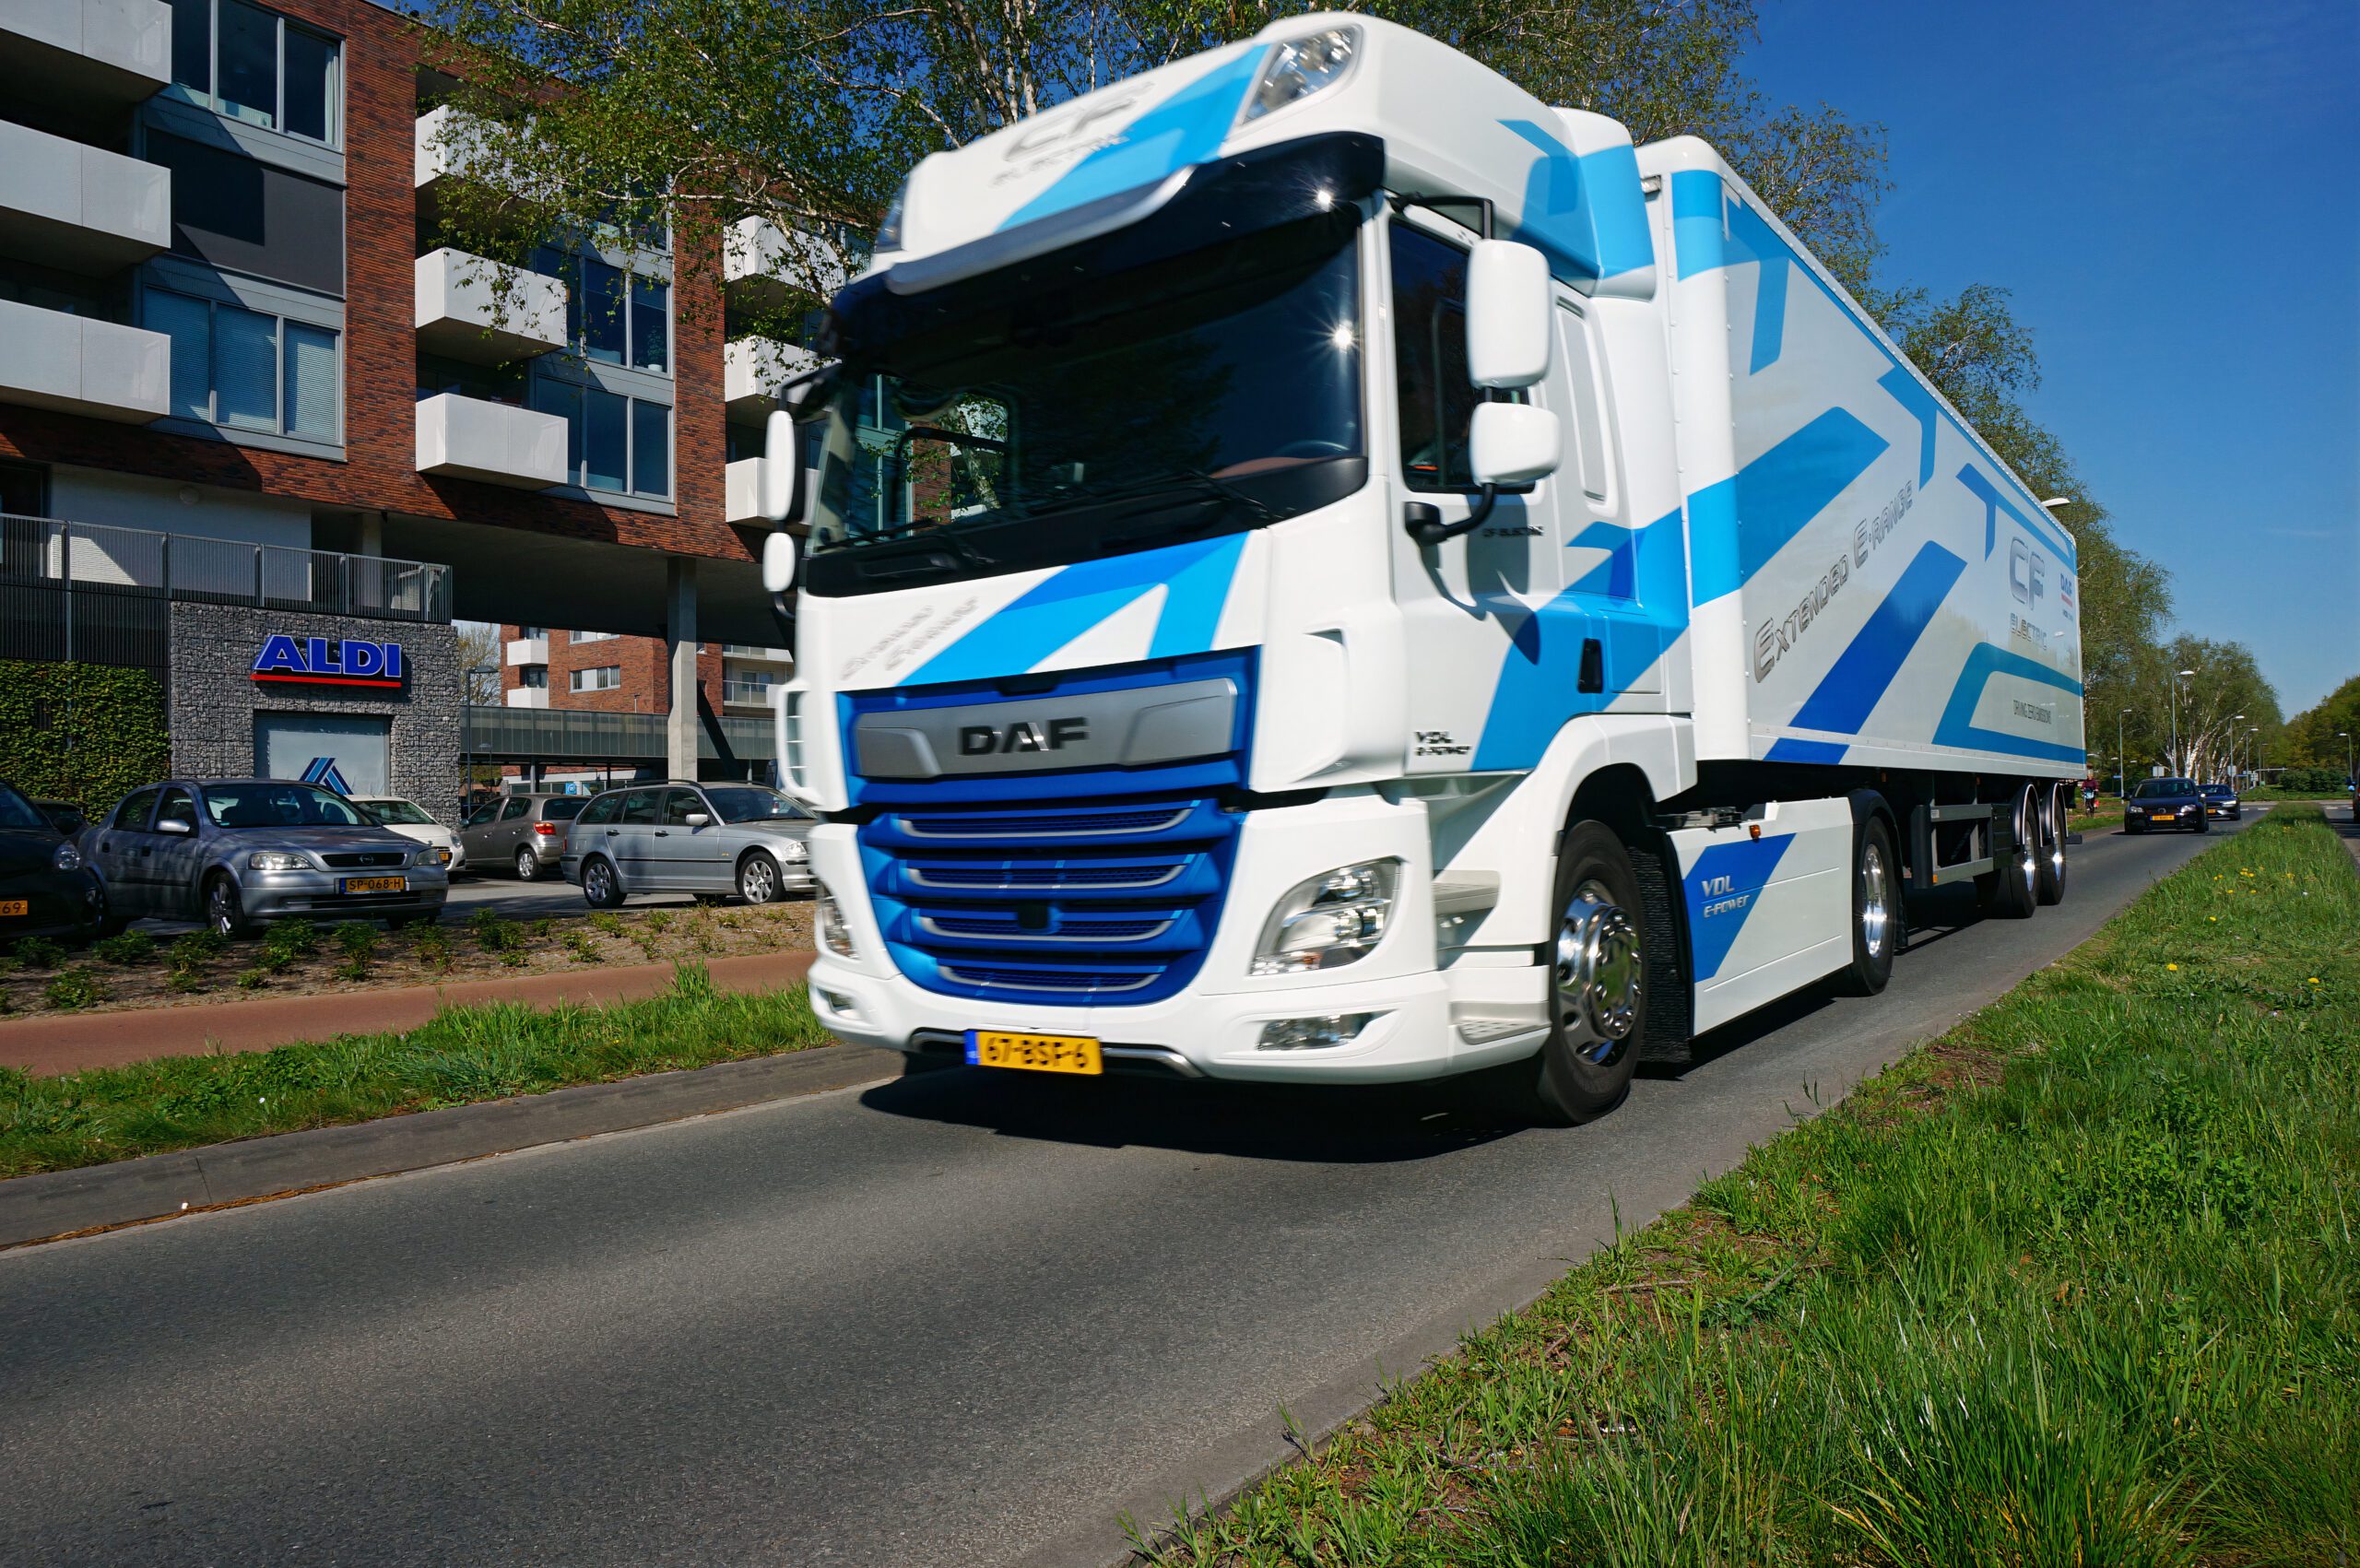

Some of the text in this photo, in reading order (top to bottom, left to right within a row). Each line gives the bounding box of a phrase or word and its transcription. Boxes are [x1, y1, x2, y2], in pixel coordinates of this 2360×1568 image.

[2010, 536, 2045, 610] CF
[252, 634, 402, 678] ALDI
[959, 716, 1090, 755] DAF
[349, 878, 401, 890] SP-068-H
[1701, 875, 1735, 898] VDL
